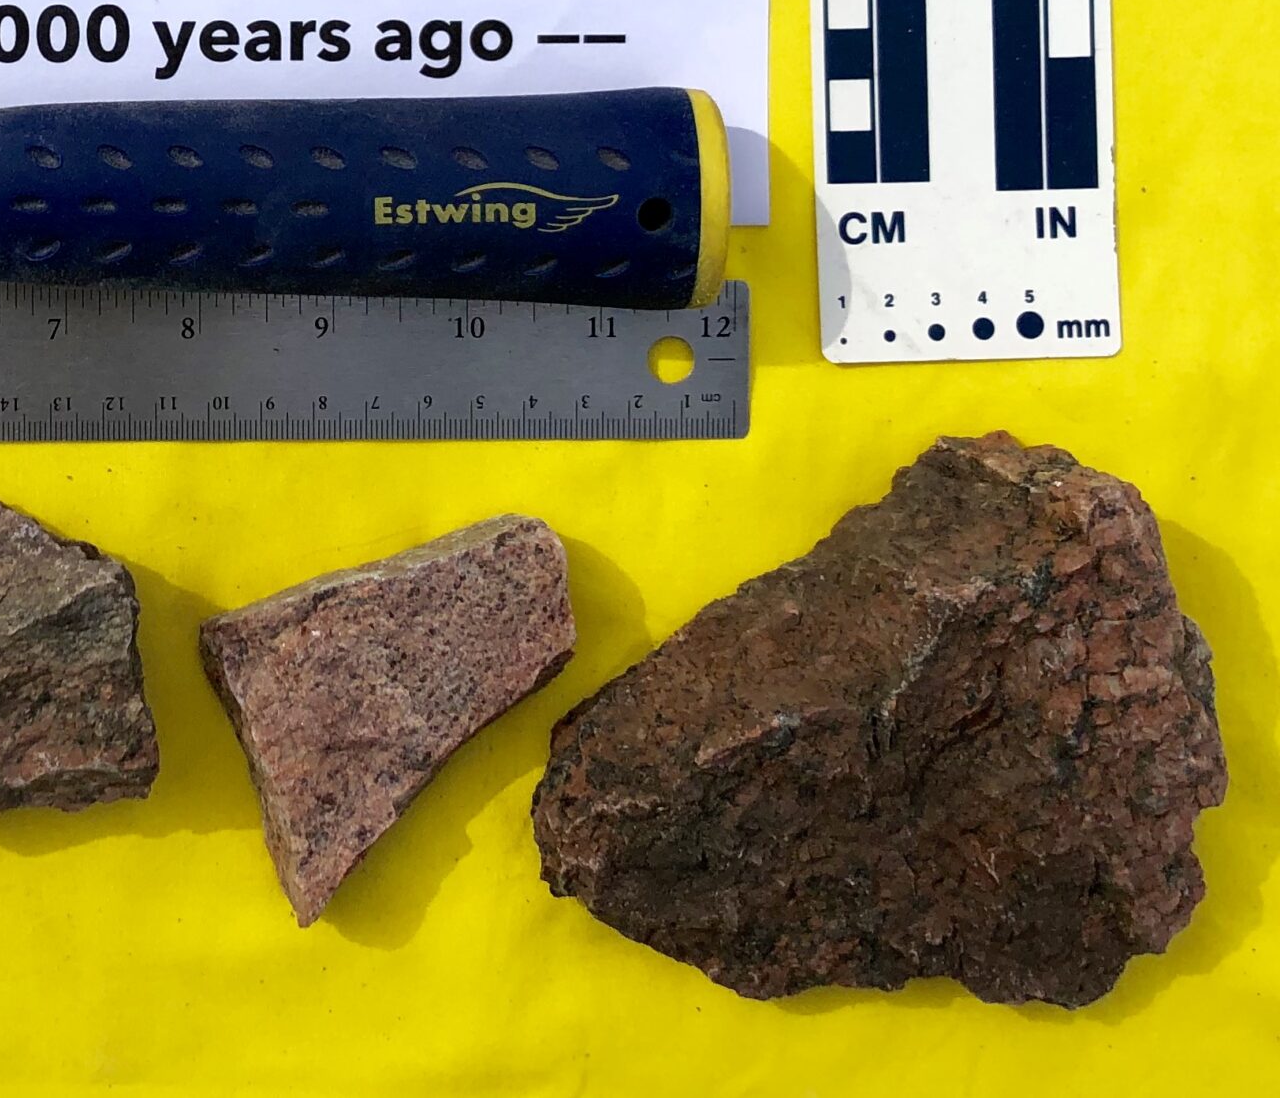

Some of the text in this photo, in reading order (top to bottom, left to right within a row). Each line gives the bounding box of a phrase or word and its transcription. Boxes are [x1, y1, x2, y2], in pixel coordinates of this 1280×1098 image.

[152, 19, 351, 80] years
[374, 19, 514, 79] ago
[374, 192, 536, 229] Estwing
[838, 206, 1077, 244] CM IN
[837, 290, 1035, 308] 1 2 3 4 5
[48, 319, 61, 340] 7
[181, 318, 195, 339] 8
[315, 317, 328, 338] 9
[454, 316, 485, 338] 10
[587, 316, 617, 338] 11
[700, 315, 730, 338] 12
[1057, 319, 1110, 339] mm
[0, 398, 18, 412] 14
[53, 397, 72, 411] 13
[106, 396, 124, 411] 12
[159, 396, 177, 411] 11
[213, 396, 229, 411] 10
[266, 396, 275, 411] 9
[319, 395, 328, 410] 8
[371, 395, 380, 410] 7
[424, 394, 433, 409] 6
[476, 394, 486, 409] 5
[529, 394, 538, 409] 4
[581, 394, 591, 409] 3
[634, 394, 643, 409] 2
[684, 394, 690, 409] 1
[701, 393, 721, 402] cm
